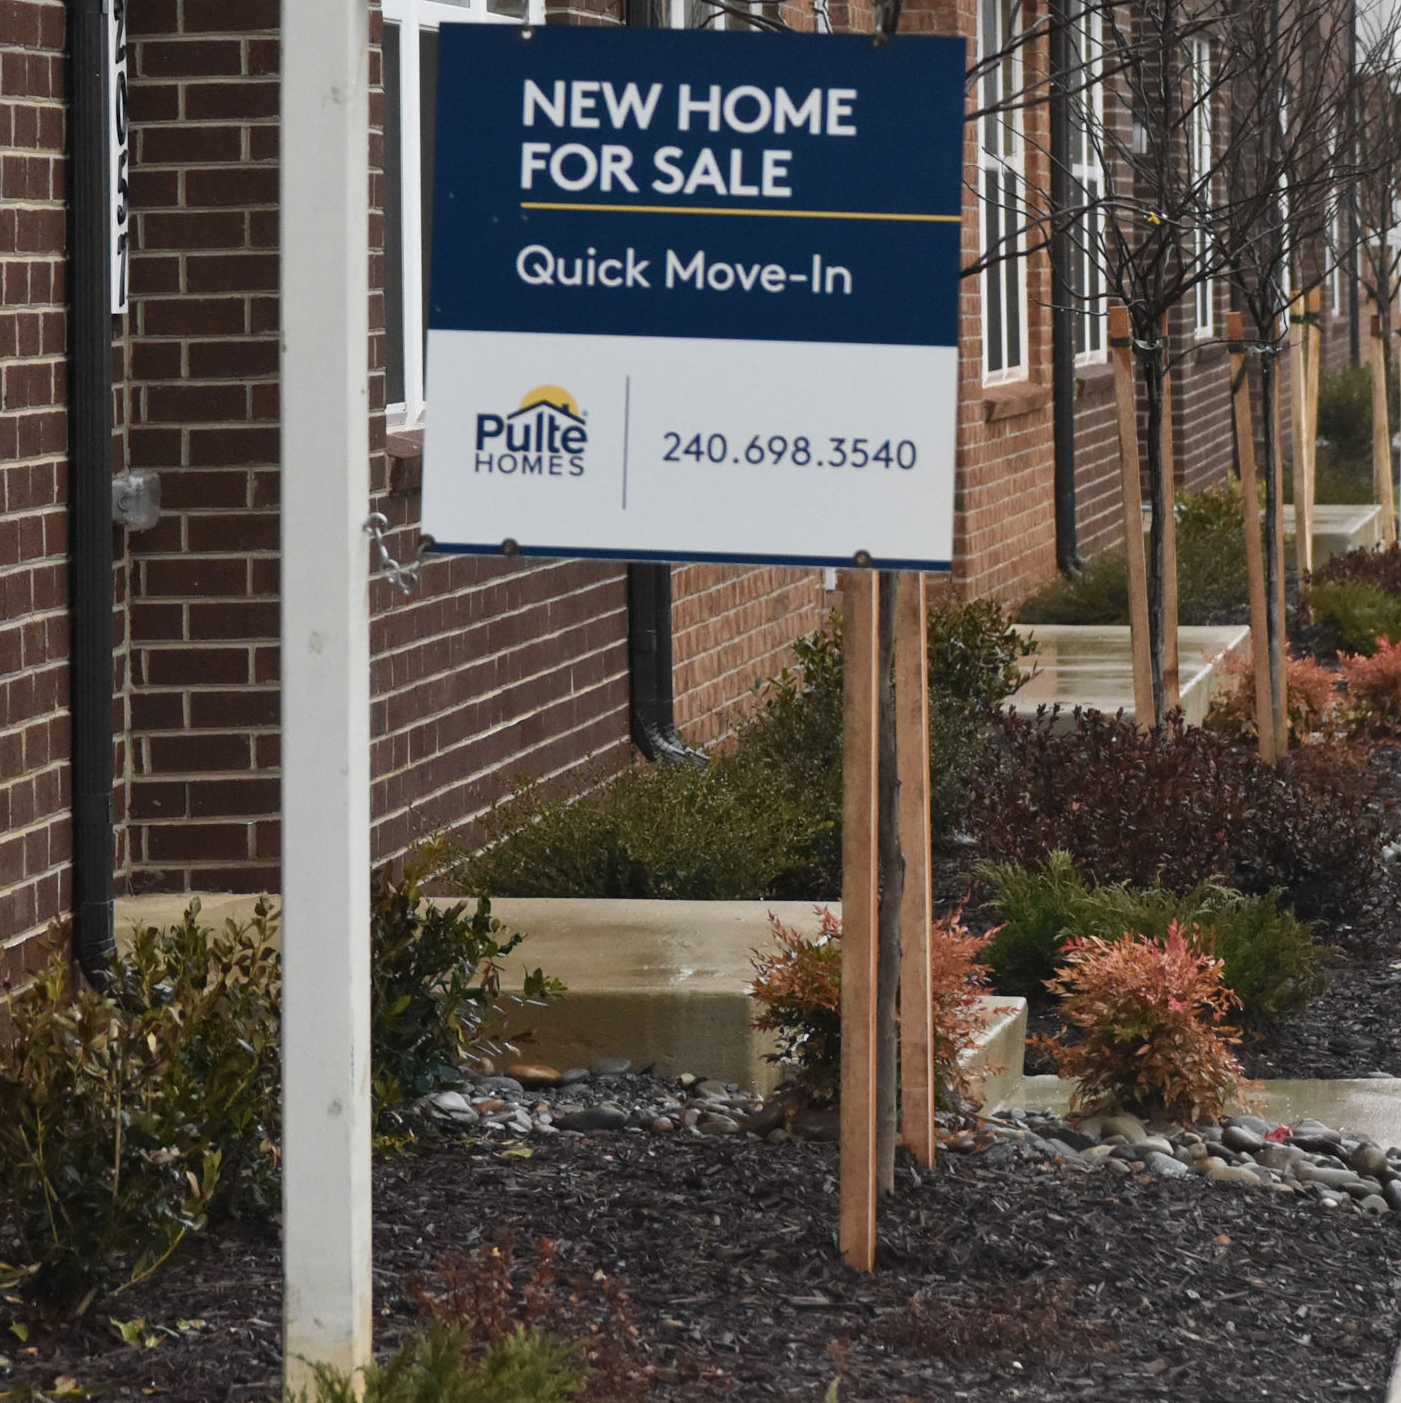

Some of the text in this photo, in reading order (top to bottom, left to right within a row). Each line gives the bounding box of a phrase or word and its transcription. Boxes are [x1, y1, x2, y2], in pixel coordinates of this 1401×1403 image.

[523, 79, 857, 136] NEW HOME
[521, 142, 793, 198] FOR SALE
[516, 244, 852, 294] Quick Move-In
[475, 410, 588, 455] Pulte
[662, 431, 917, 470] 240.698.3540
[474, 452, 585, 477] HOMES
